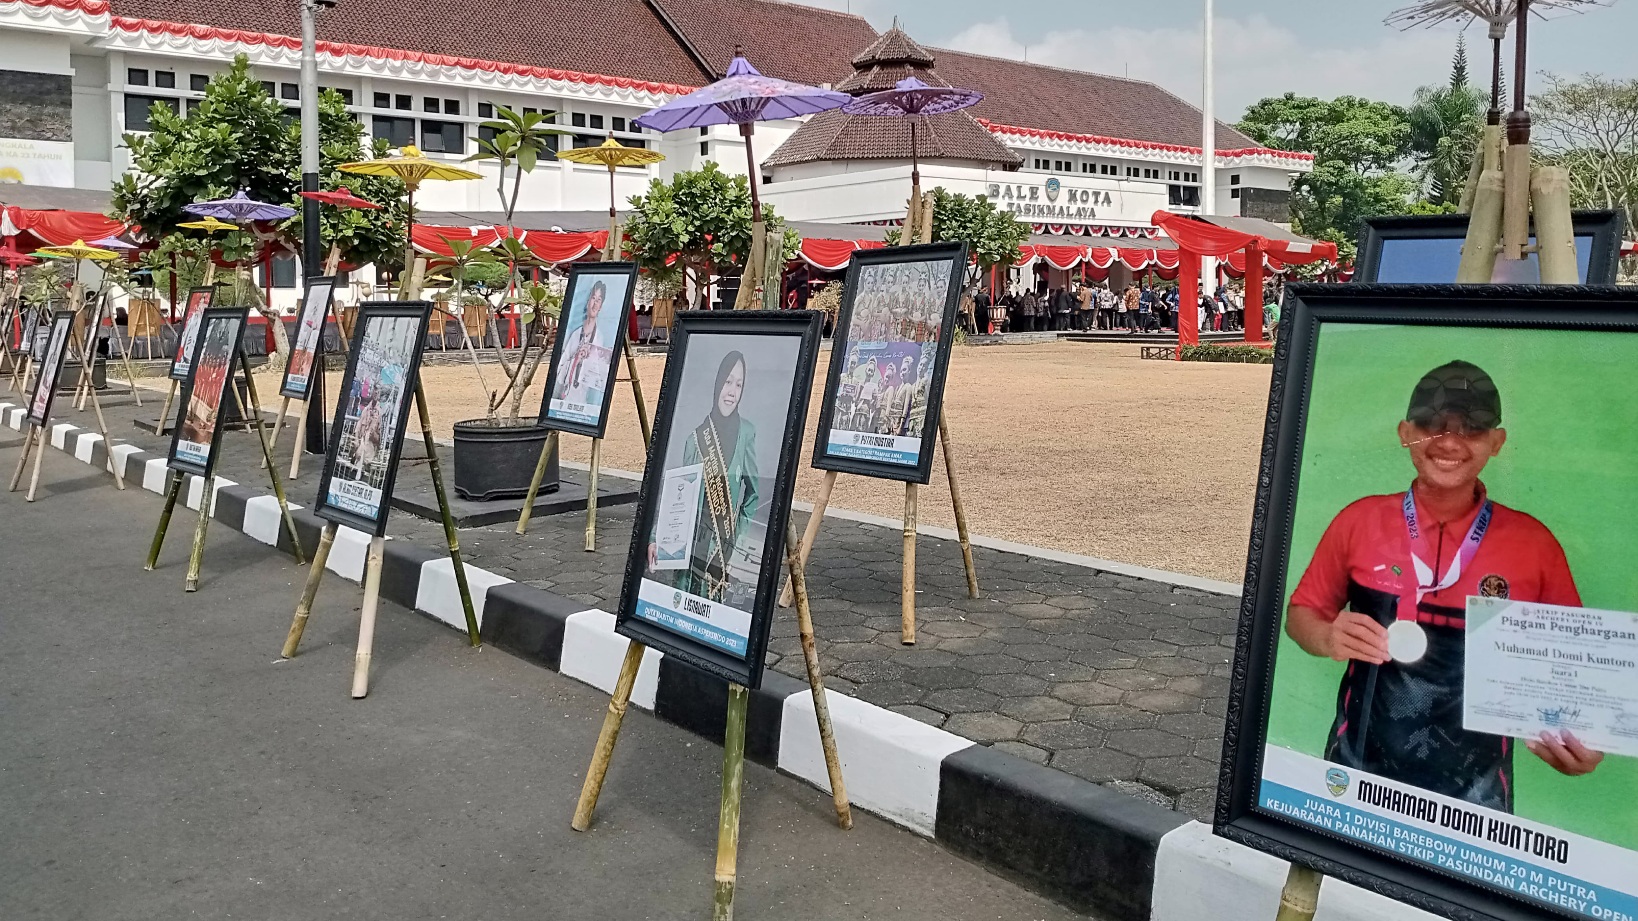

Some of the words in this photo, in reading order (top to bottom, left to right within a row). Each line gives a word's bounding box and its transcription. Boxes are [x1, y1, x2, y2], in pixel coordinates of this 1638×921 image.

[989, 184, 1039, 201] BALE
[1067, 189, 1112, 206] KOTA
[1007, 203, 1096, 217] TASIKMALAYA
[703, 456, 721, 515] ASPEKSINDO
[1406, 513, 1419, 539] 2023
[1470, 513, 1488, 543] STKIP
[1501, 616, 1546, 630] Piagam
[1550, 621, 1636, 640] Penghargaan
[1494, 641, 1549, 657] Muhamad
[1552, 649, 1583, 662] Domi
[1587, 653, 1635, 668] Kuntoro
[1550, 668, 1573, 678] Juara
[1357, 780, 1438, 823] MUHAMAD
[1440, 804, 1485, 838] DOMI
[1487, 817, 1569, 864] KUNTORO
[1266, 797, 1332, 828] KEJUARAAN
[1335, 820, 1396, 849] PANAHAN
[1399, 842, 1434, 861] STKIP
[1437, 854, 1515, 888] PASUNDAN
[1519, 882, 1588, 912] ARCHERY
[1591, 905, 1634, 921] OPEN
[1304, 799, 1341, 819] JUARA
[1345, 811, 1351, 822] 1
[1354, 814, 1390, 834] DIVISI
[1393, 827, 1457, 856] BAREBOW
[1460, 850, 1506, 872] UMUM
[1510, 864, 1526, 878] 20
[1530, 871, 1544, 884] M
[1548, 876, 1597, 902] PUTRA
